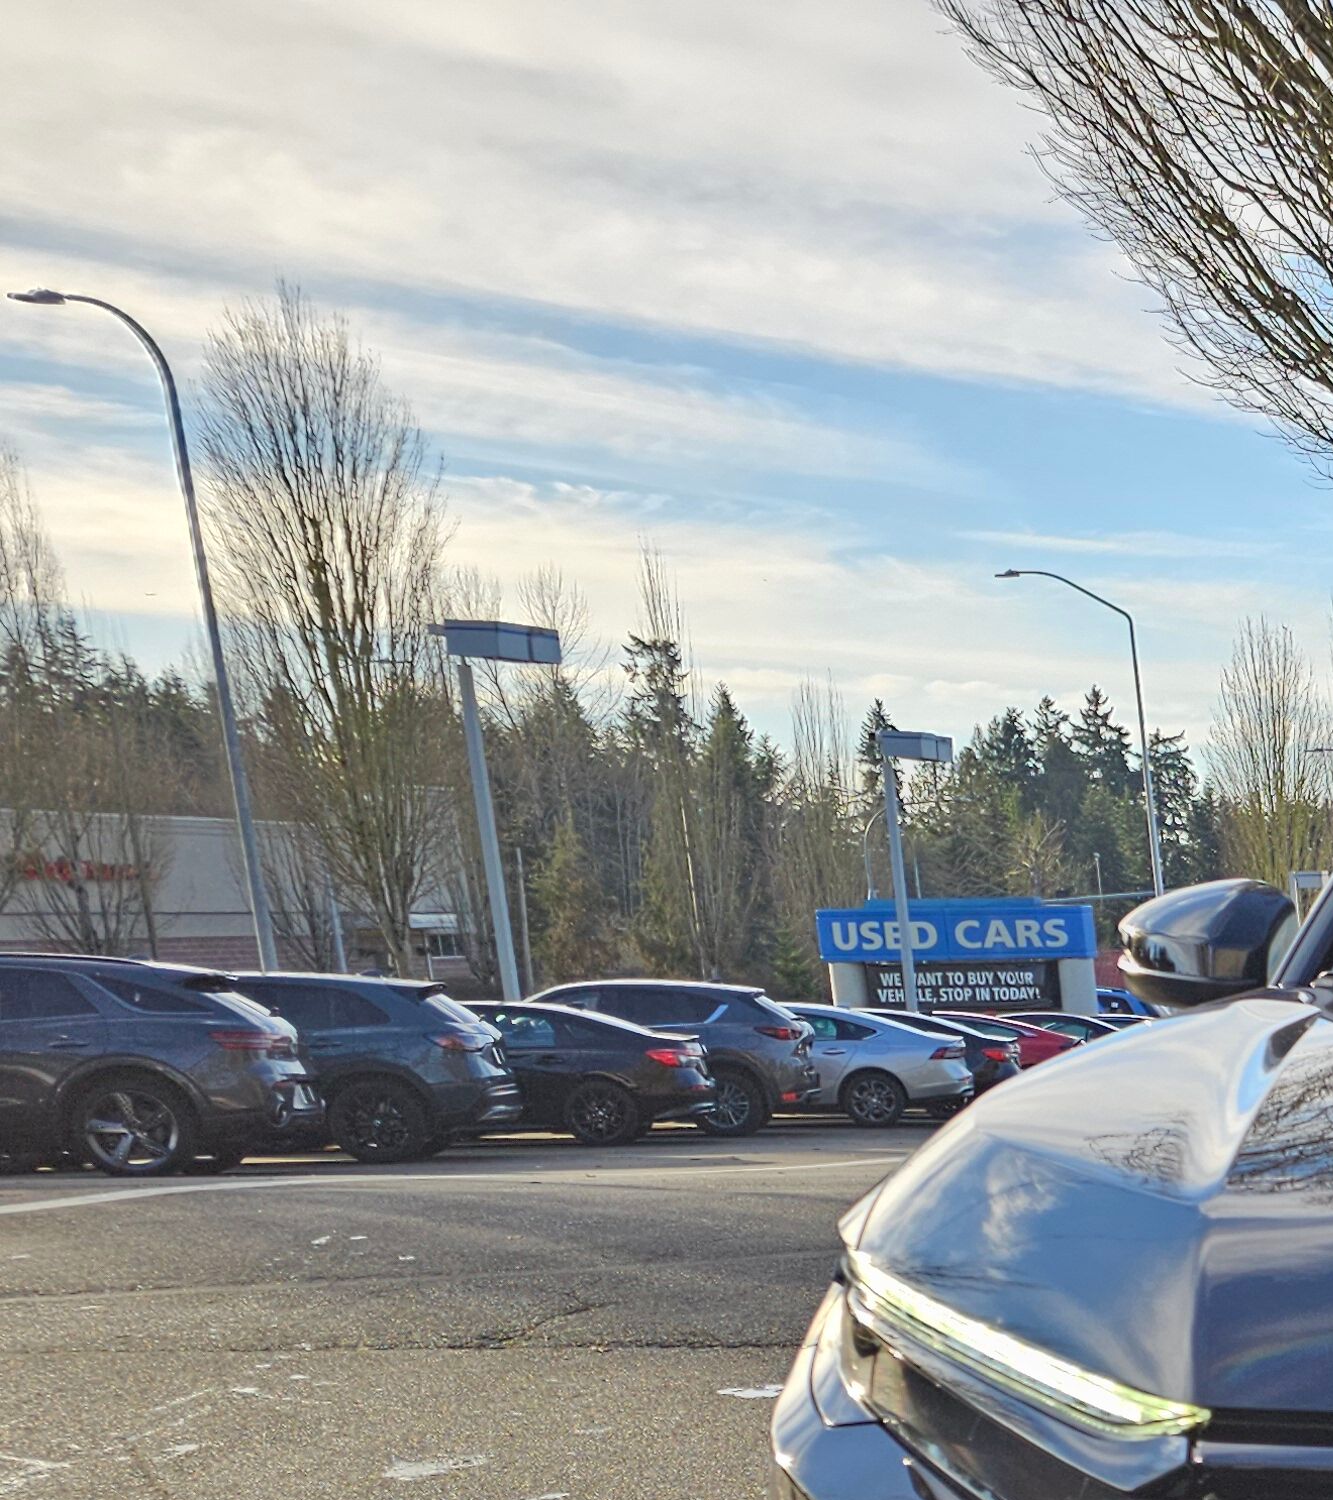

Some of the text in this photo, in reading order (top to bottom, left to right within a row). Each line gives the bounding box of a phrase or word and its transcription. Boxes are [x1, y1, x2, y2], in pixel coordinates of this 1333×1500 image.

[831, 918, 1069, 951] USED CARS
[879, 971, 1034, 986] WE ANT TO BUY YOUR
[877, 986, 1041, 1004] VEHLE, STOP IN TODAY!
